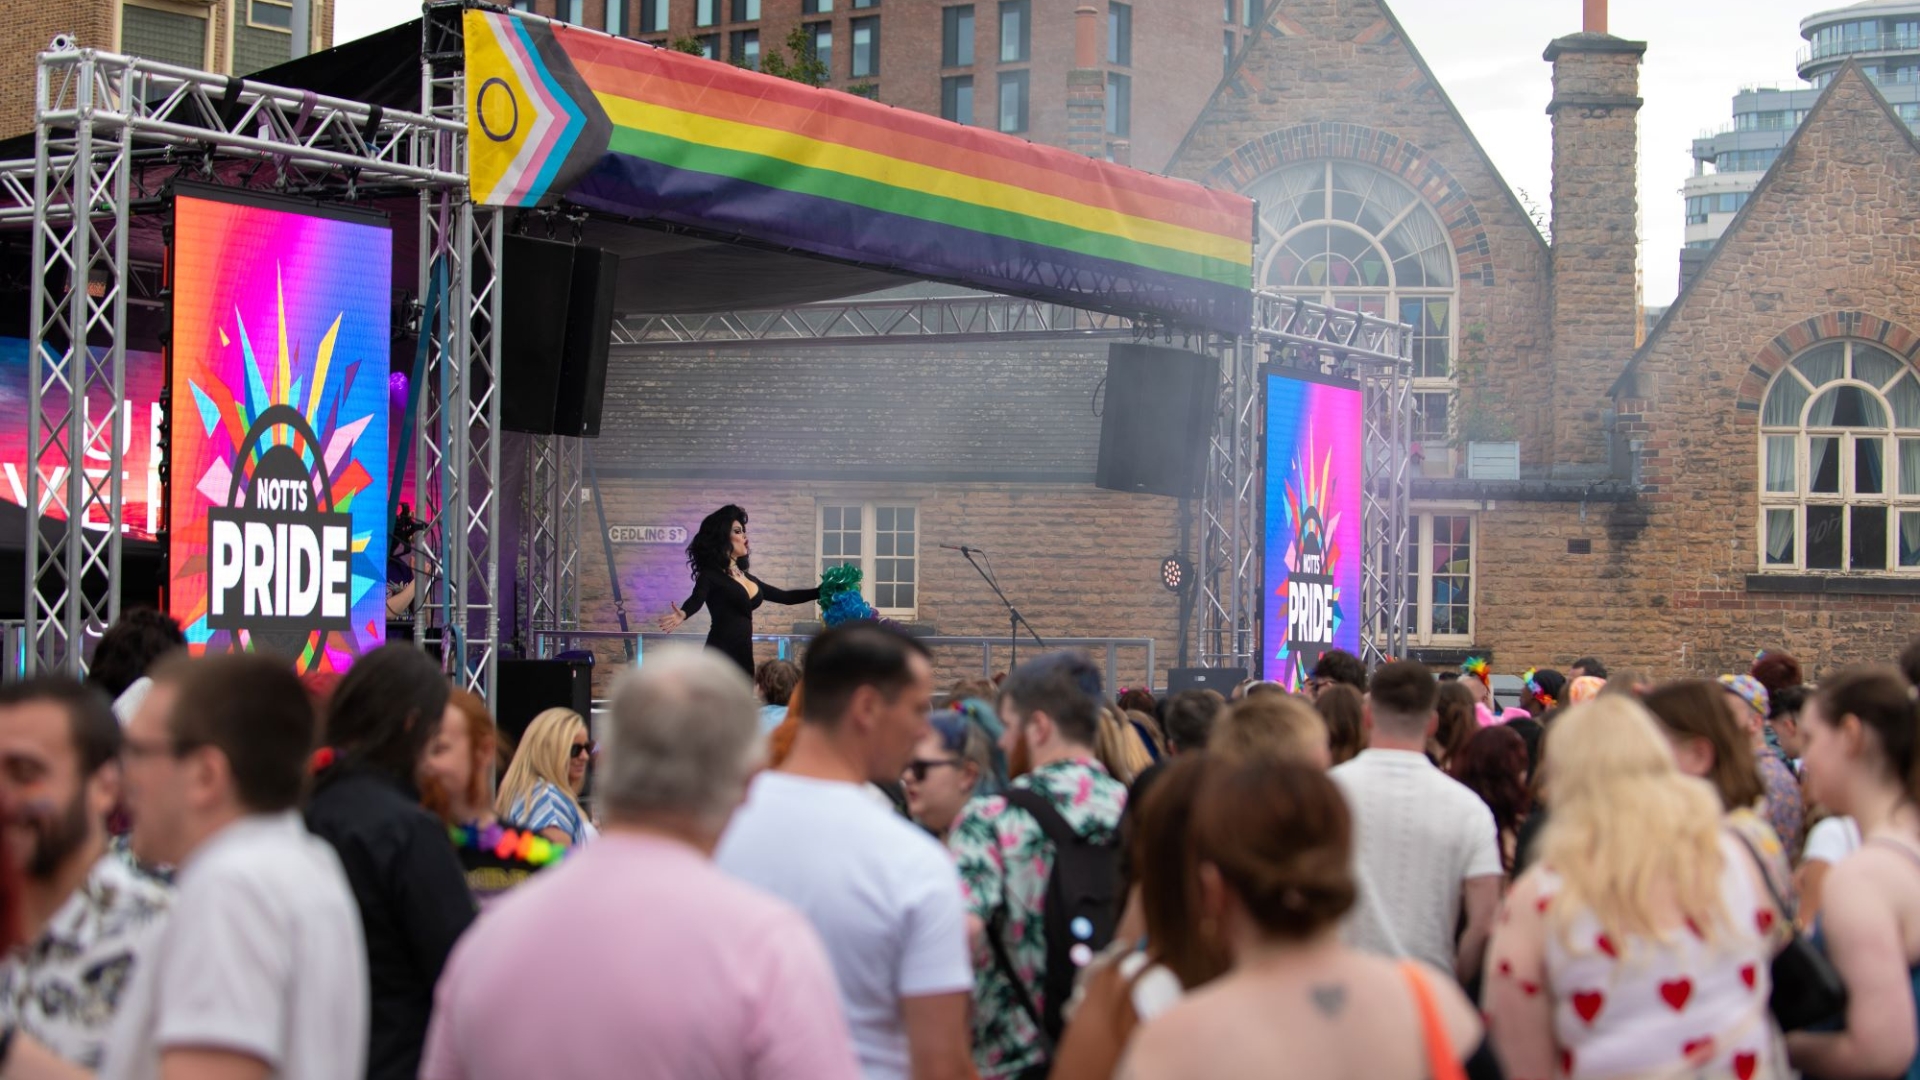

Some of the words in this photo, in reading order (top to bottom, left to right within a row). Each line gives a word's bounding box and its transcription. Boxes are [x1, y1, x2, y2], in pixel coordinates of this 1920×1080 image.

[256, 477, 308, 512] NOTTS
[211, 519, 348, 618] PRIDE
[1303, 554, 1320, 575] NOTTS
[1288, 581, 1333, 643] PRIDE
